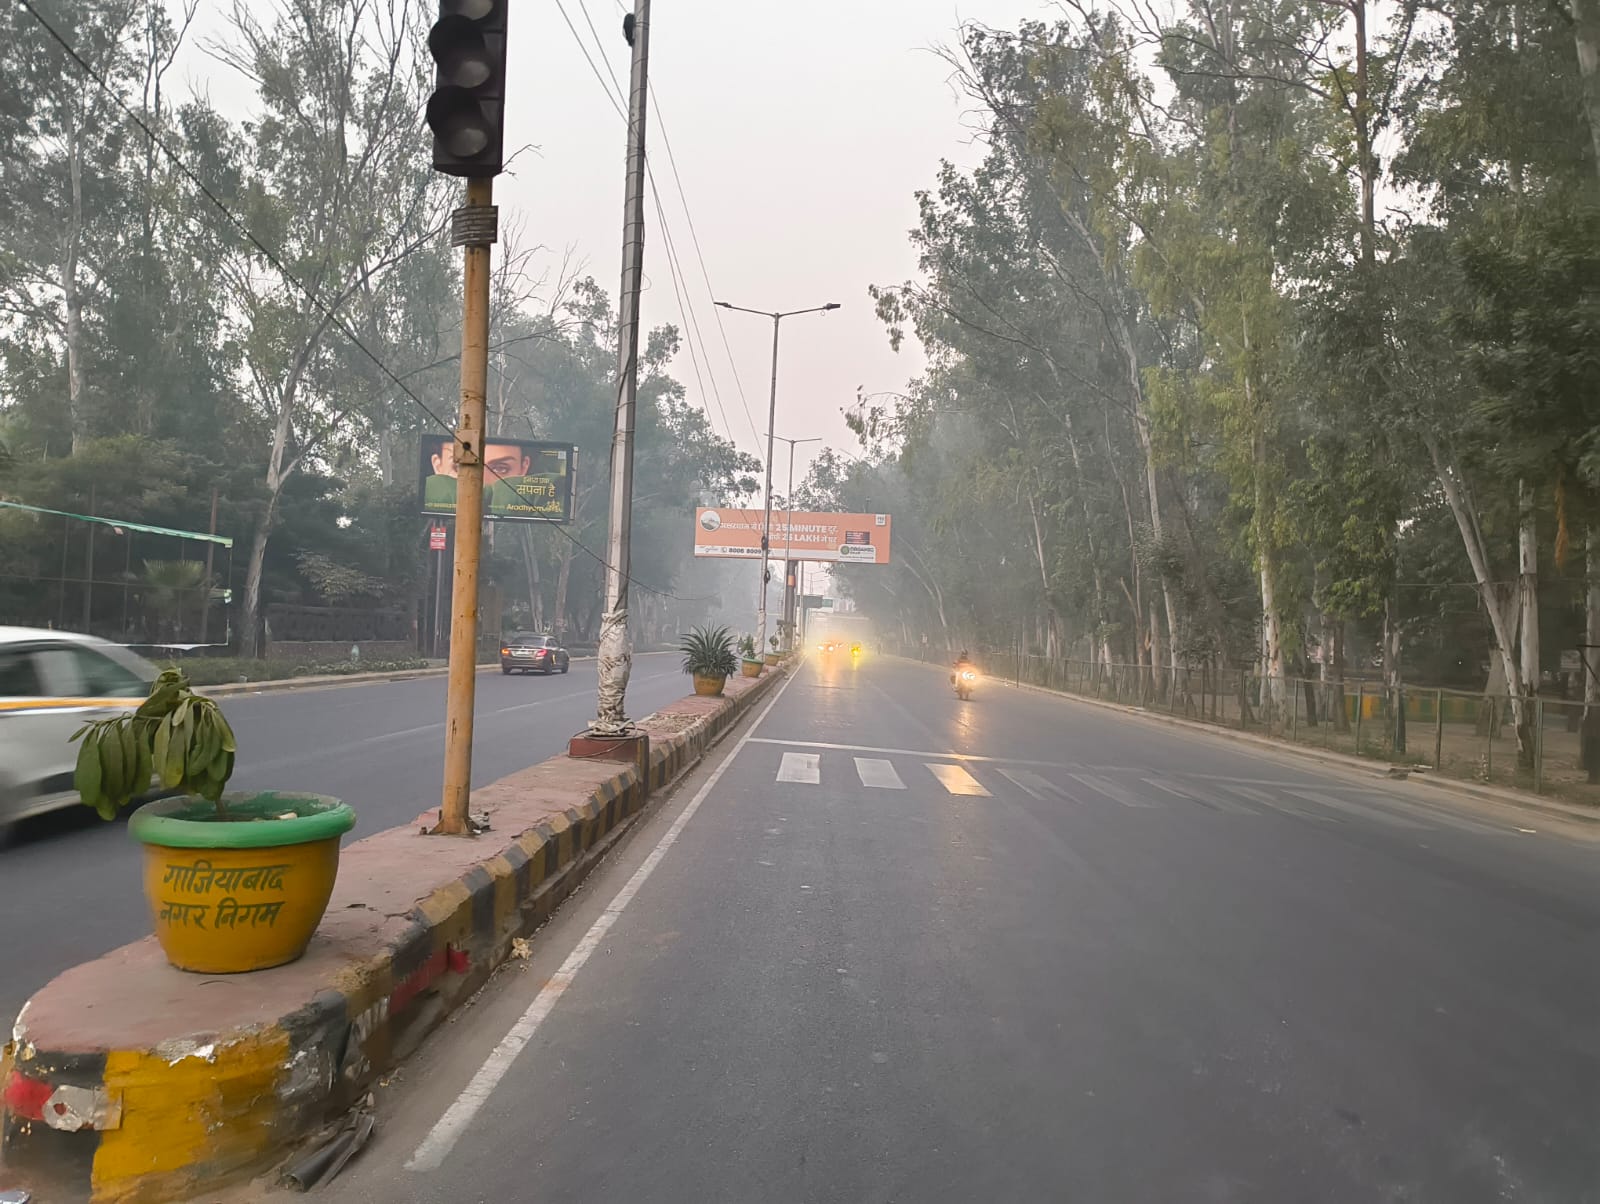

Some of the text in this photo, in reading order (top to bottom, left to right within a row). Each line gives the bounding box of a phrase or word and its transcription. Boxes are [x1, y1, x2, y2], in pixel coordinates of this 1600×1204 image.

[516, 483, 556, 497] सपना है
[776, 523, 788, 532] 25
[789, 524, 827, 533] MINUTE
[794, 534, 820, 542] LAKH
[163, 859, 294, 893] गाजियाबाद
[159, 897, 286, 930] नगर निगम
